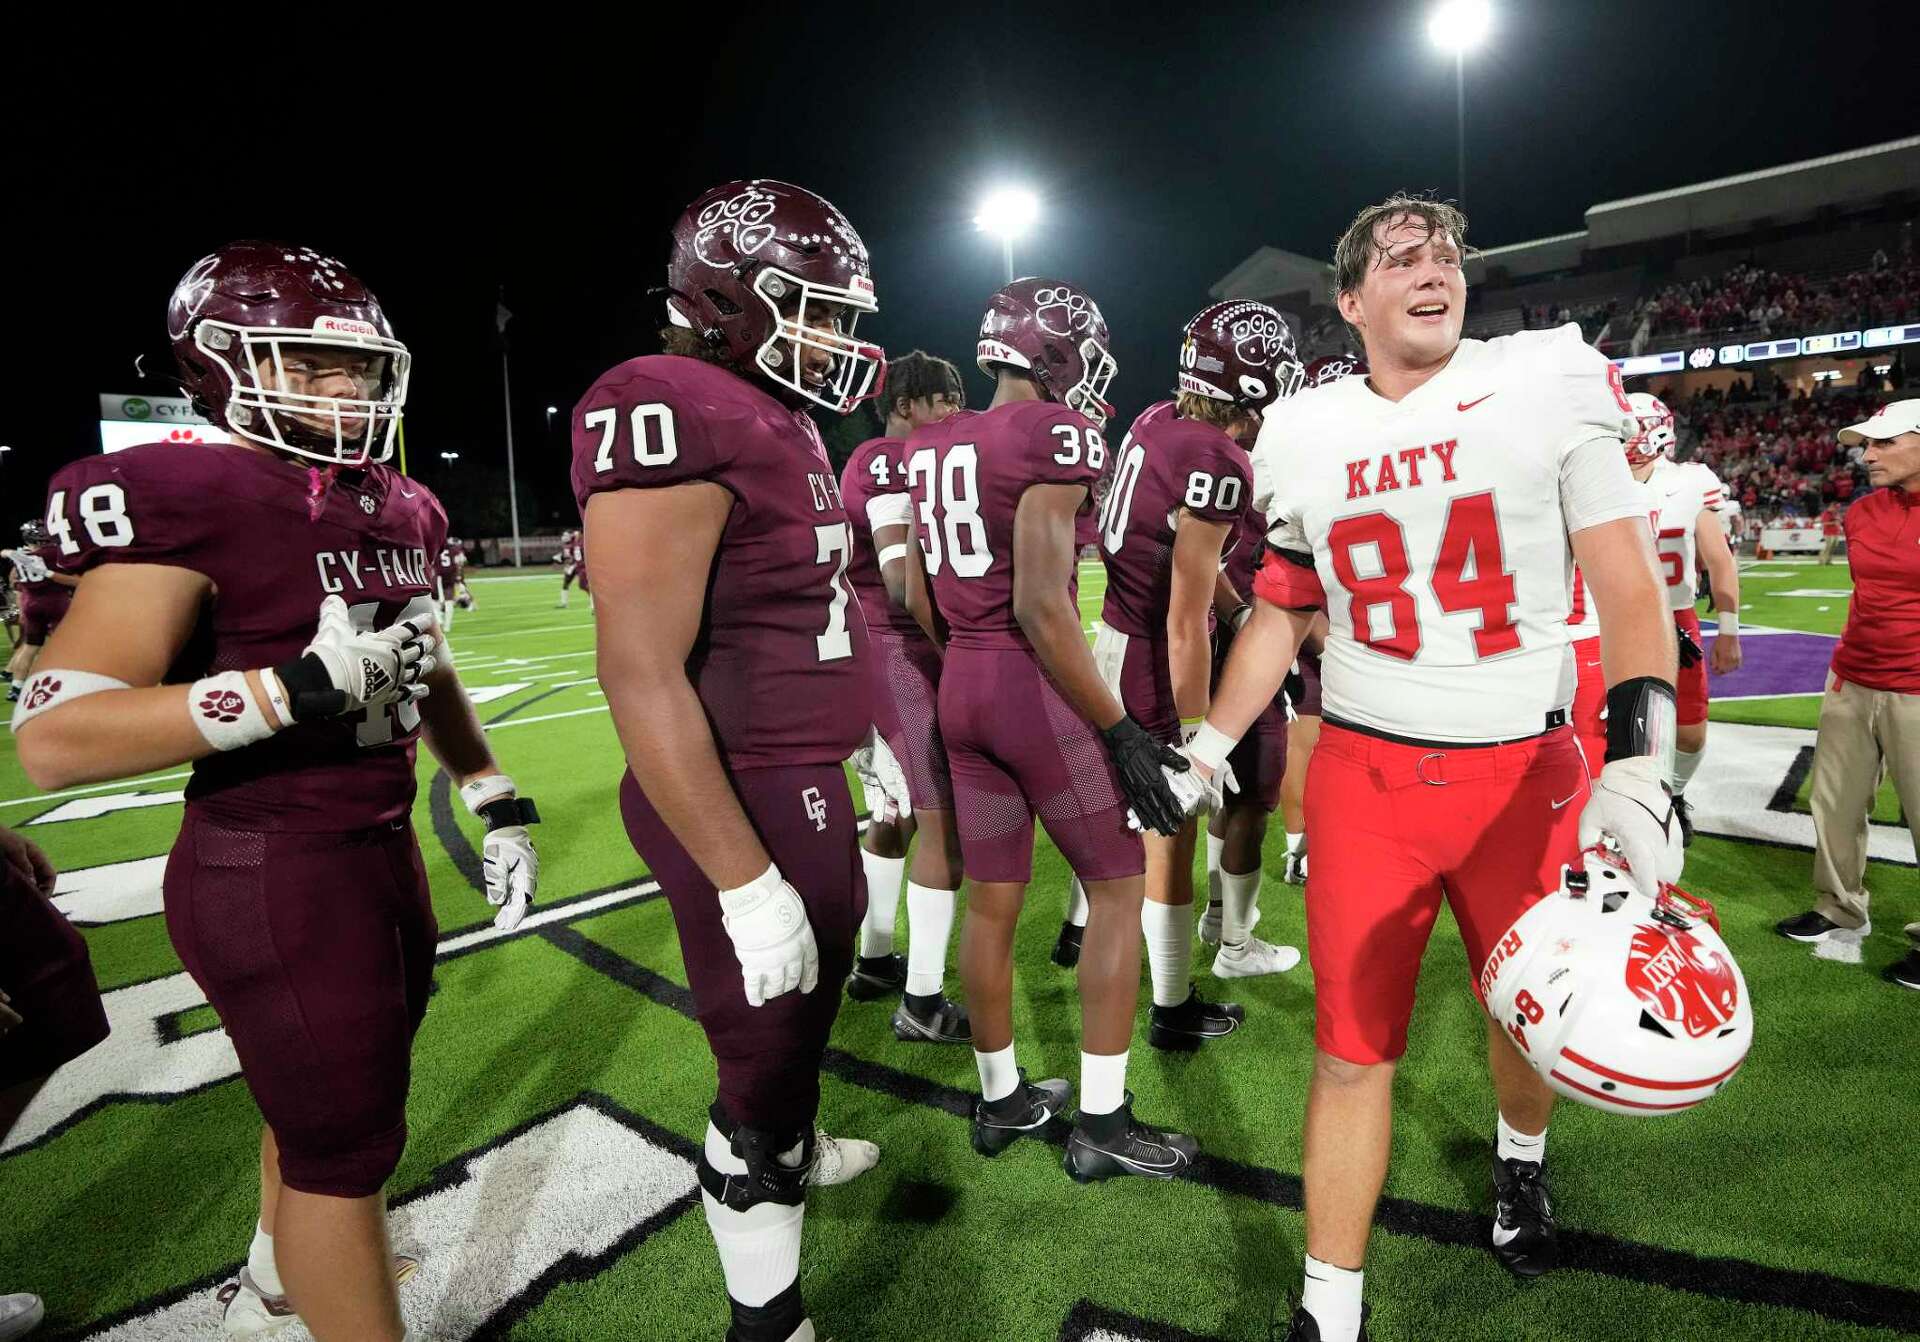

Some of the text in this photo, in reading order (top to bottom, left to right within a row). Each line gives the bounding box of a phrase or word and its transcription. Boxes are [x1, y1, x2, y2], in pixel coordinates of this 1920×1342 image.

[585, 402, 678, 474] 70
[1051, 424, 1105, 470] 38
[1344, 438, 1459, 502] KATY
[46, 483, 135, 556] 48
[908, 443, 995, 578] 38
[1185, 471, 1242, 511] 80
[316, 548, 429, 593] CY-FAIR
[814, 521, 854, 662] 7
[1326, 488, 1526, 665] 84
